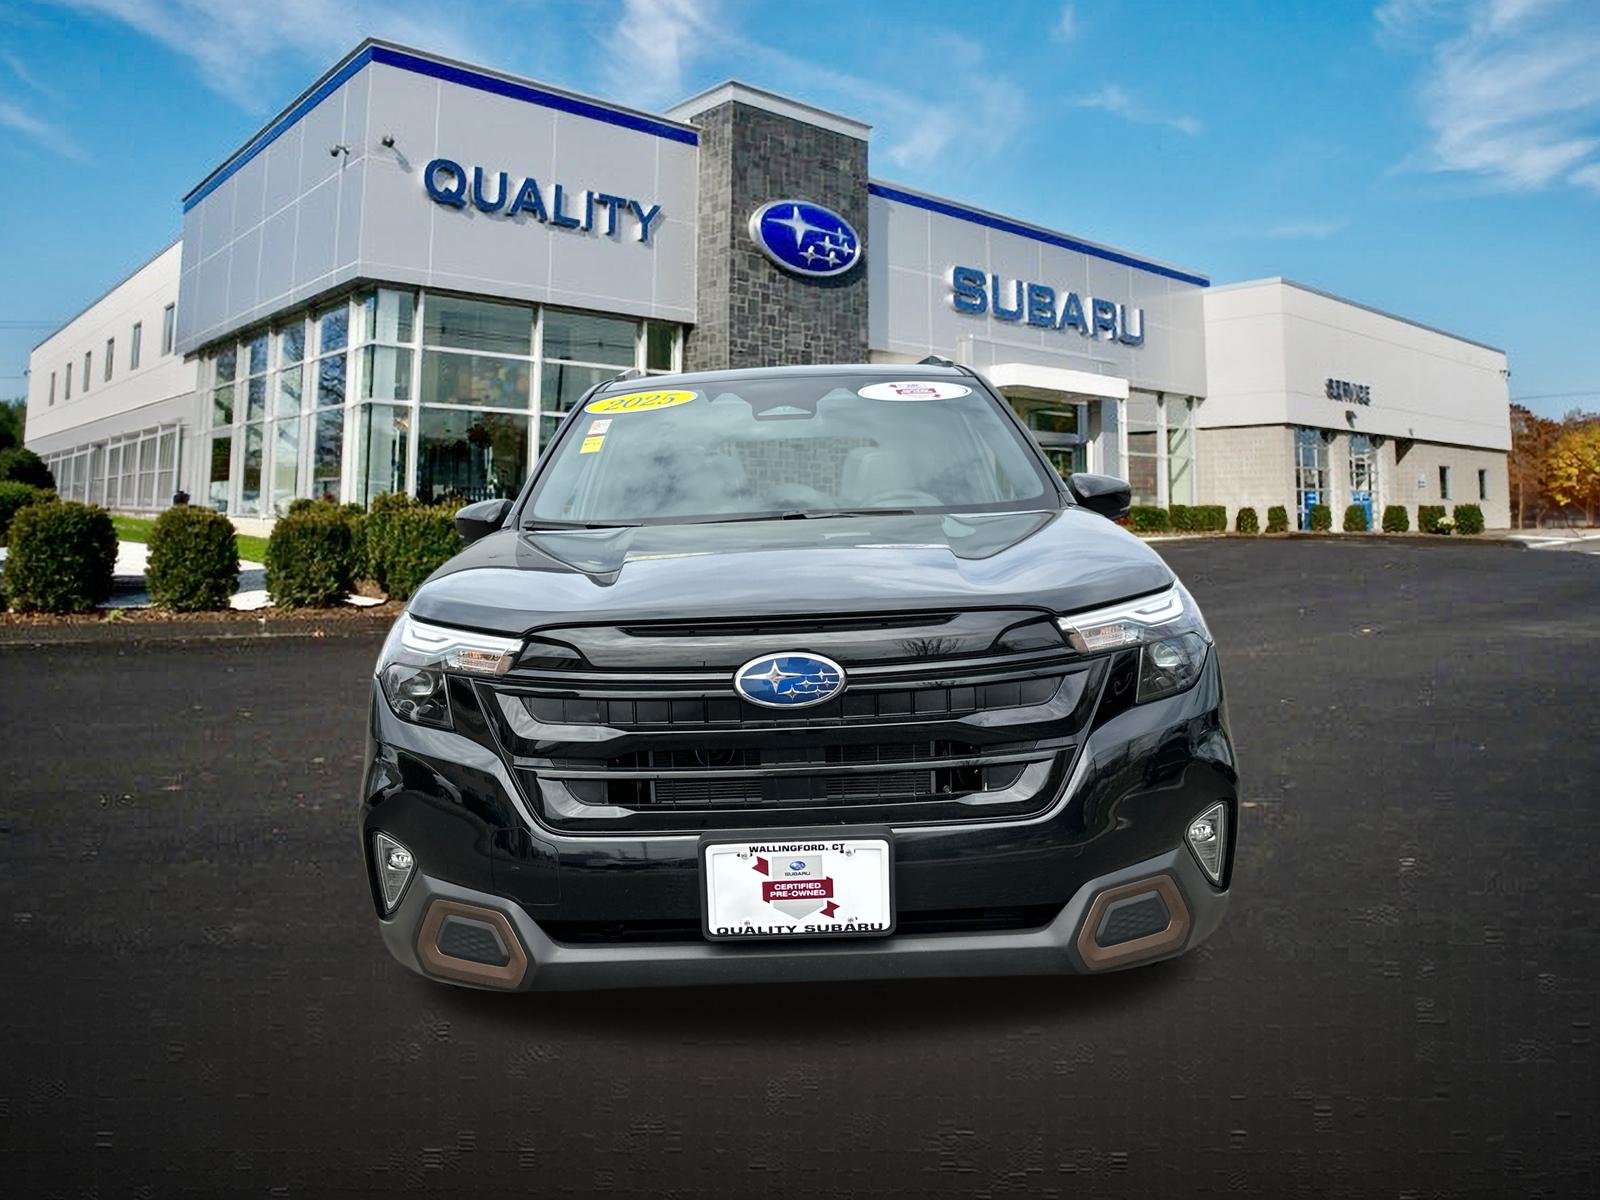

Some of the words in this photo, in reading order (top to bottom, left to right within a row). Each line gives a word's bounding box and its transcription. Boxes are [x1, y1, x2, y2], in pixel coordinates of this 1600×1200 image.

[424, 158, 661, 242] QUALITY
[952, 265, 1145, 347] SUBARU
[602, 393, 680, 411] 2025
[832, 843, 845, 851] CT
[774, 882, 822, 890] CERTIFIED
[770, 889, 826, 897] PRE-OWNED
[716, 925, 798, 935] QUALITY
[804, 922, 883, 933] SUBARU
